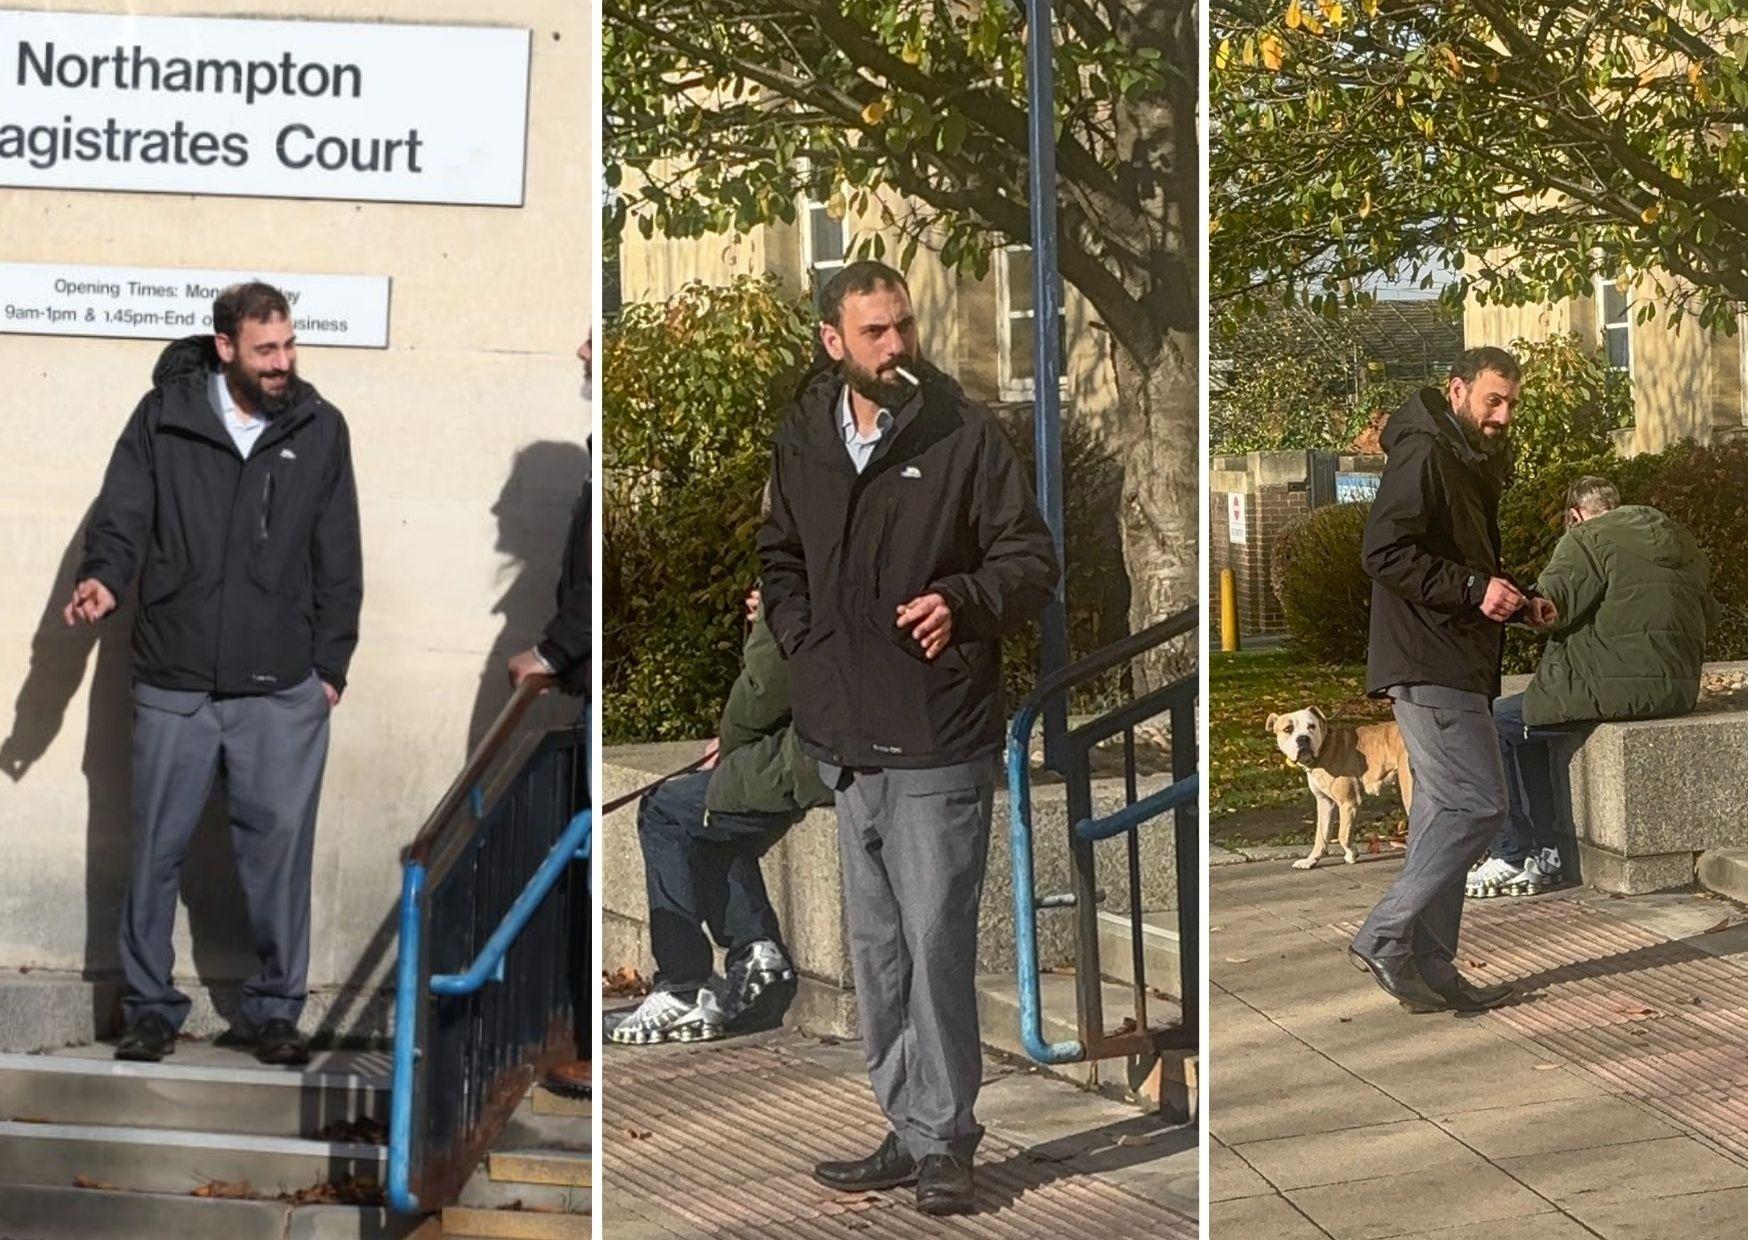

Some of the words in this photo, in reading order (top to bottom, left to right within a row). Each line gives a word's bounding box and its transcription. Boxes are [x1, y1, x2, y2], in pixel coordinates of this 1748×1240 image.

[17, 40, 362, 105] Northampton
[0, 115, 249, 169] agistrates
[275, 123, 423, 173] Court
[54, 278, 120, 298] Opening
[127, 281, 178, 298] Times:
[185, 284, 219, 299] Mon
[5, 304, 77, 324] 9am-1pm
[84, 307, 96, 322] &
[103, 308, 195, 327] 1.45pm-End
[202, 314, 213, 327] o
